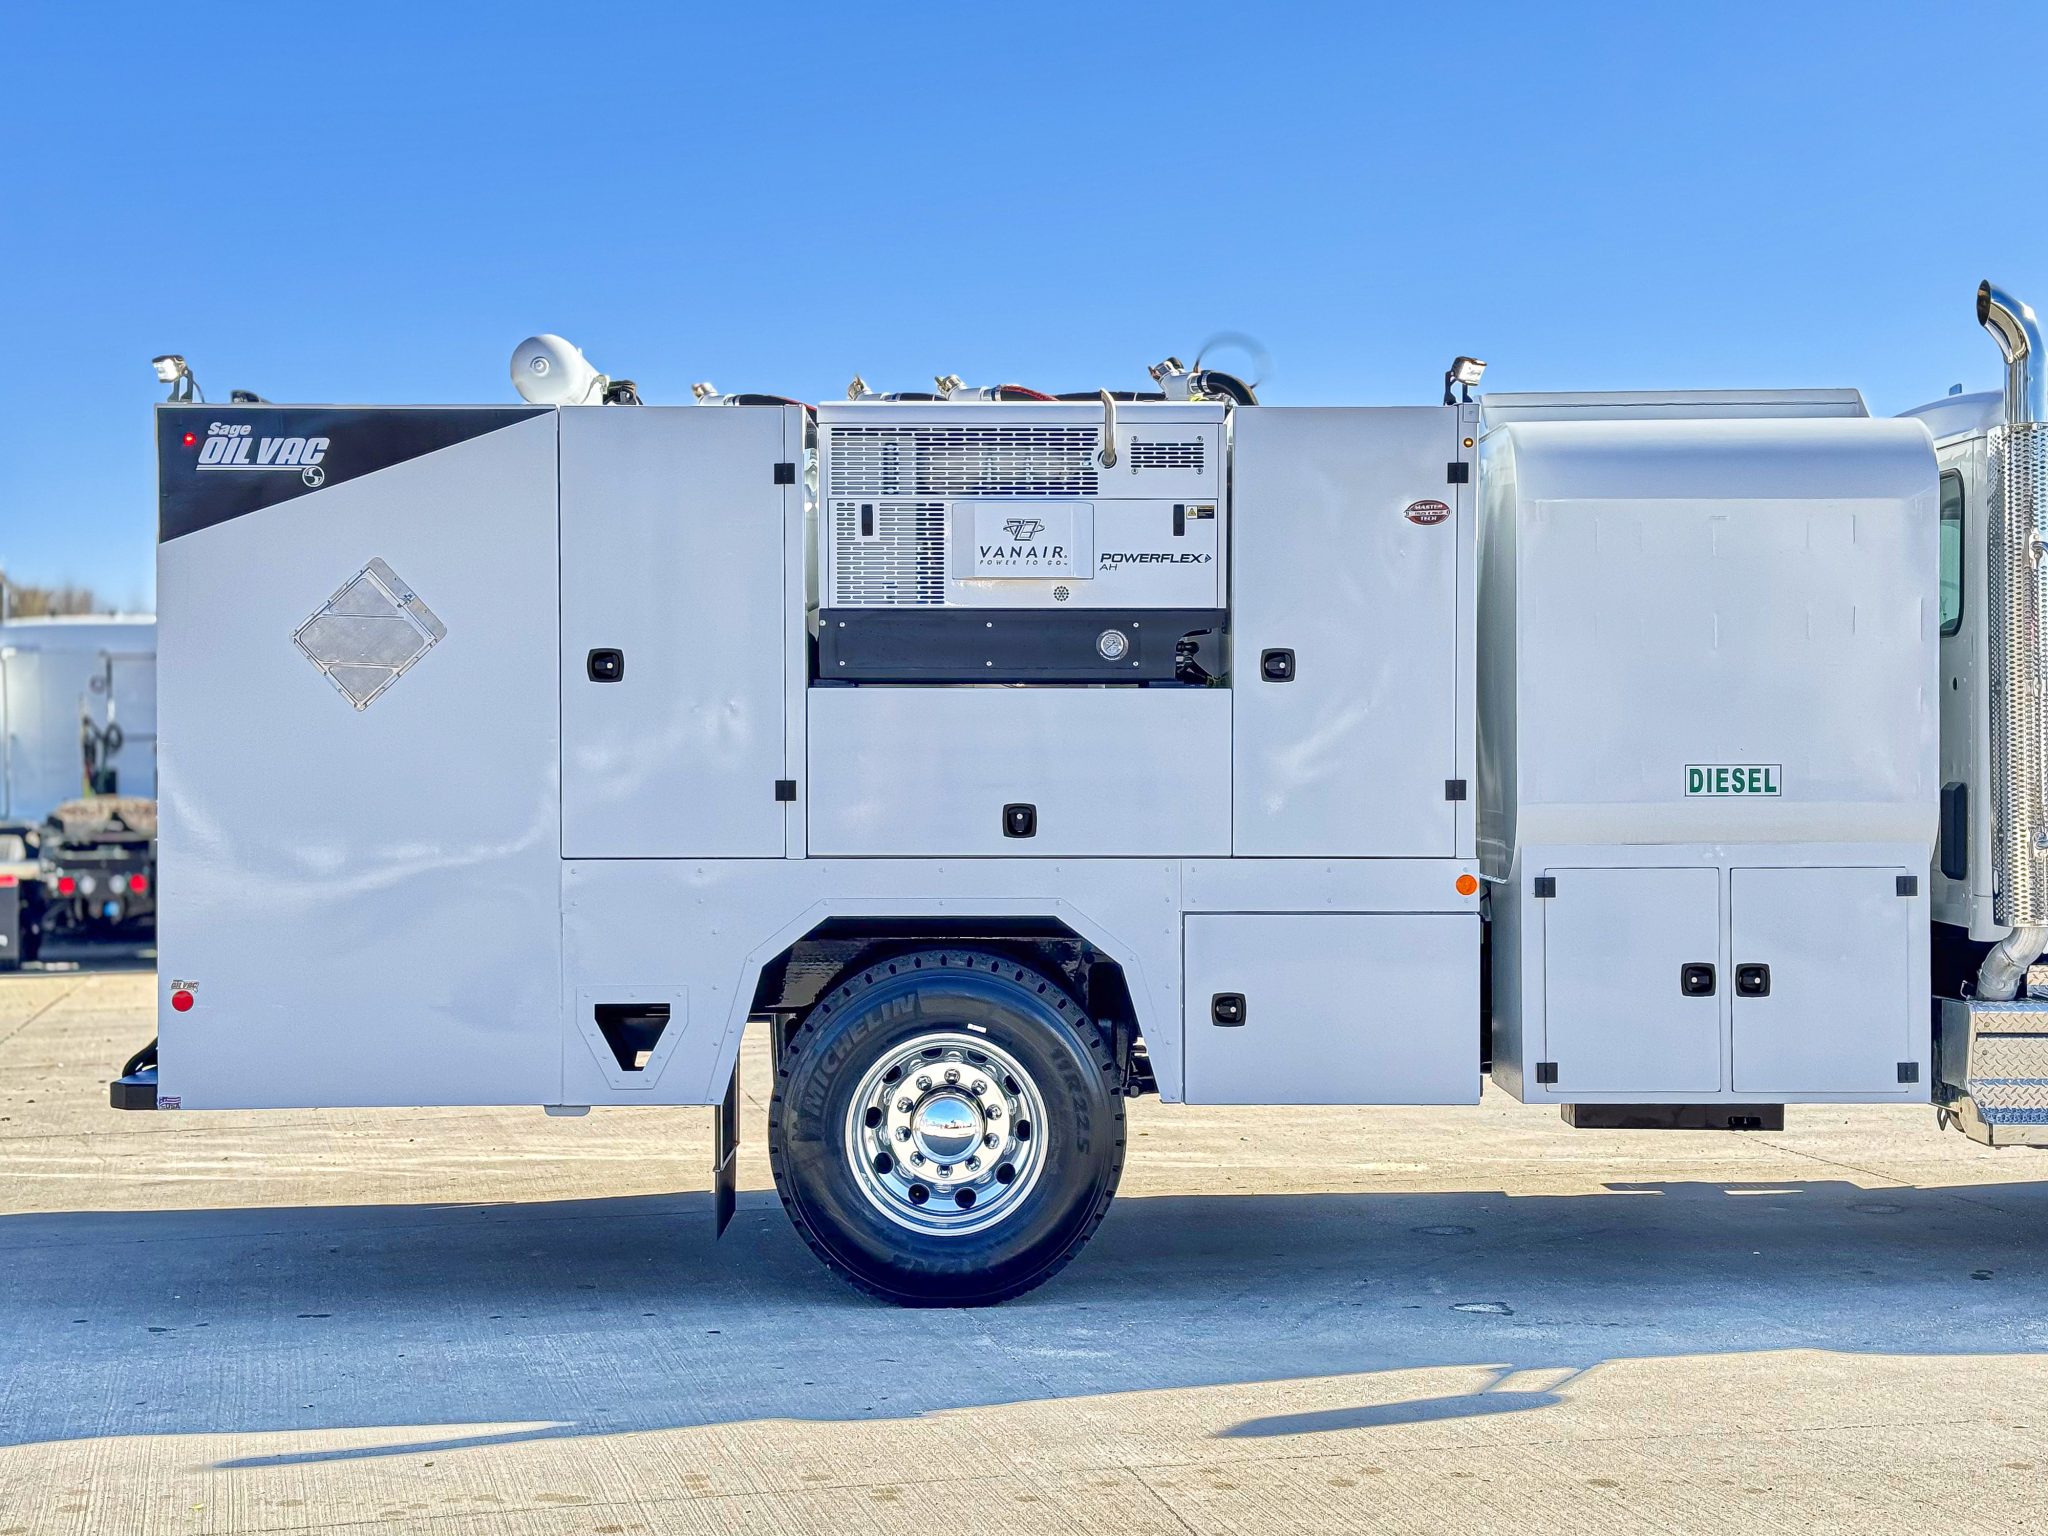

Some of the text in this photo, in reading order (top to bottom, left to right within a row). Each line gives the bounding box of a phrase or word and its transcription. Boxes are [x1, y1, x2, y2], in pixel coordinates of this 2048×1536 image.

[207, 422, 251, 437] Sage
[1100, 553, 1204, 564] POWERFLEX
[1099, 563, 1118, 572] AH
[1689, 767, 1777, 793] DIESEL
[802, 992, 918, 1117] MICHELIN
